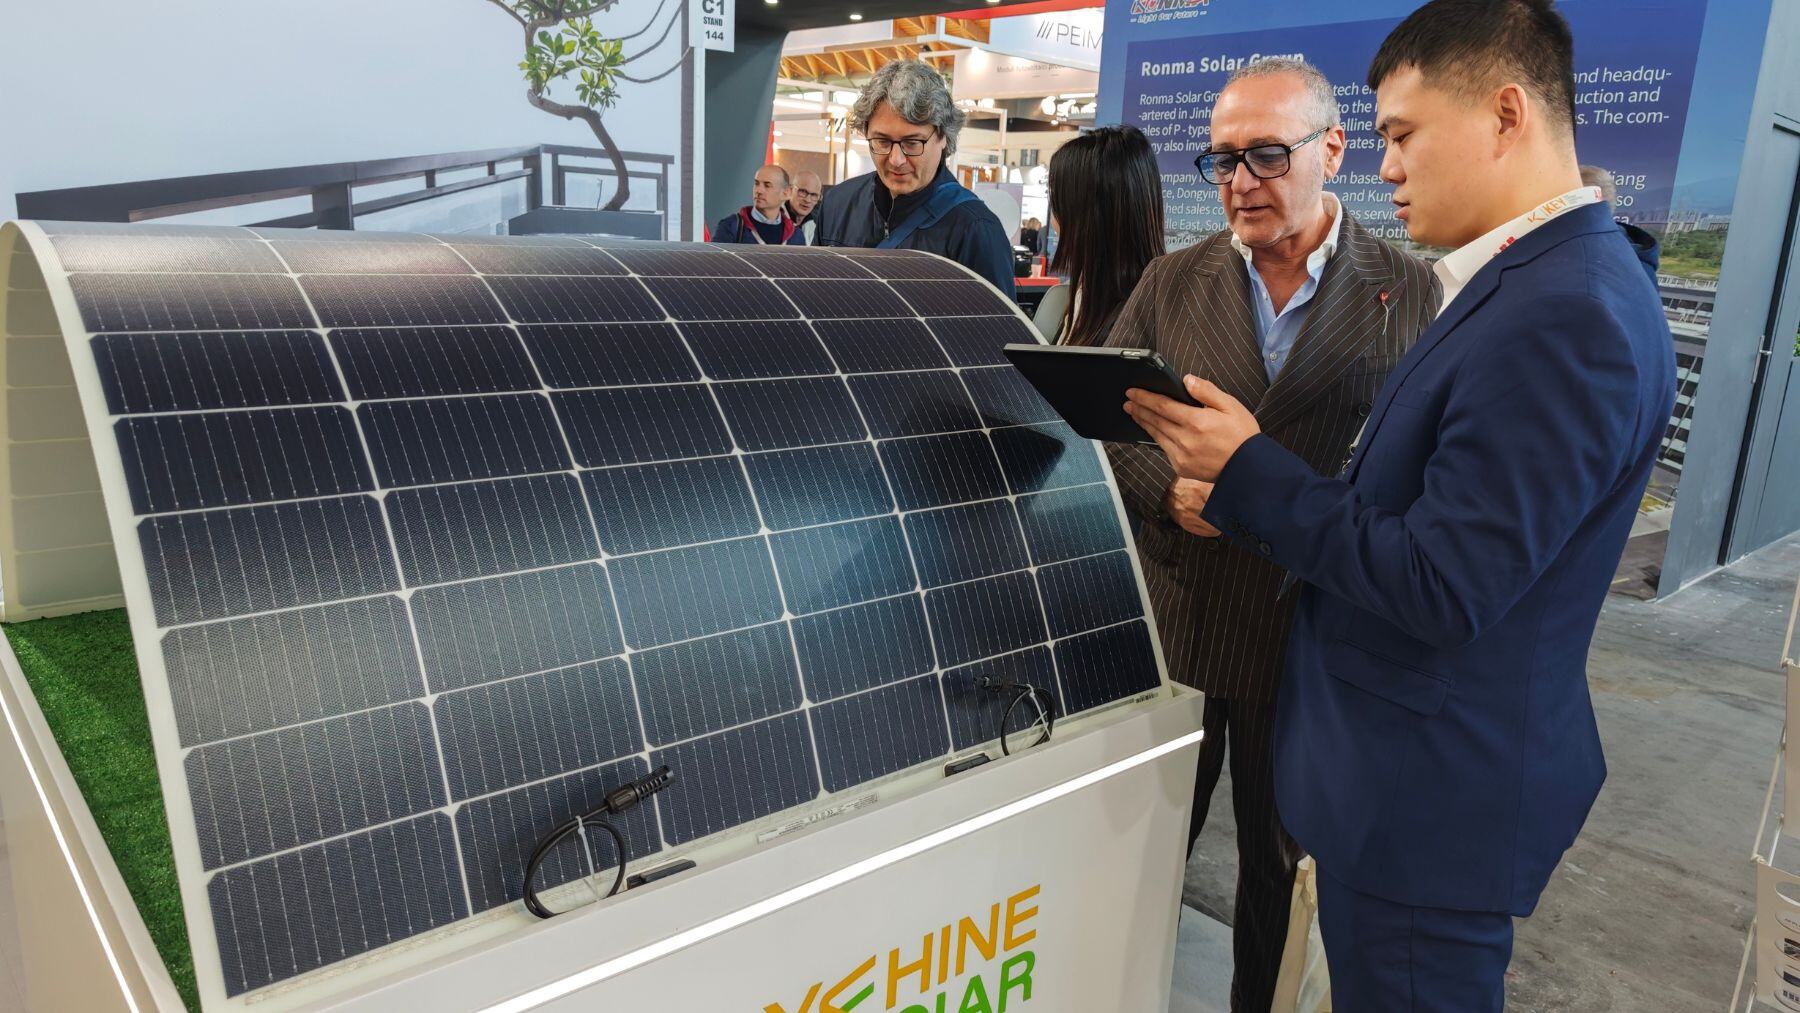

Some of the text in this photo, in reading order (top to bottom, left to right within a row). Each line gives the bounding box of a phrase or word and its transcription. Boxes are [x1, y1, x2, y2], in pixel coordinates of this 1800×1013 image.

[702, 0, 725, 15] C1
[703, 16, 723, 26] STAND
[705, 30, 724, 41] 144
[1057, 23, 1103, 49] PEIM
[1141, 60, 1195, 76] Ronma
[1200, 55, 1245, 73] Solar
[1140, 93, 1174, 105] Ronma
[1175, 91, 1202, 103] Solar
[1203, 90, 1222, 102] Gro
[1333, 82, 1359, 97] tech
[1602, 65, 1672, 85] headqu-
[1139, 108, 1176, 121] -artered
[1178, 107, 1188, 120] in
[1189, 107, 1212, 120] Jinh
[1352, 100, 1372, 113] the
[1574, 89, 1624, 105] uction
[1628, 86, 1661, 103] and
[1161, 123, 1173, 137] of
[1173, 125, 1181, 133] P
[1188, 124, 1211, 138] type
[1339, 117, 1373, 132] alline
[1593, 109, 1623, 124] The
[1626, 111, 1670, 124] com-
[1151, 142, 1161, 155] ny
[1163, 140, 1184, 152] also
[1185, 139, 1212, 152] inves
[1343, 136, 1375, 150] rates
[1160, 172, 1198, 186] ompany
[1350, 171, 1384, 185] bases
[1162, 189, 1175, 200] ce,
[1176, 187, 1224, 202] Dongying
[1342, 189, 1365, 202] and
[1367, 189, 1392, 202] Kun
[1165, 202, 1184, 215] hed
[1185, 203, 1211, 216] sales
[1212, 206, 1226, 216] co
[1364, 207, 1398, 221] servic
[1543, 198, 1567, 216] KEY
[1179, 219, 1204, 232] East,
